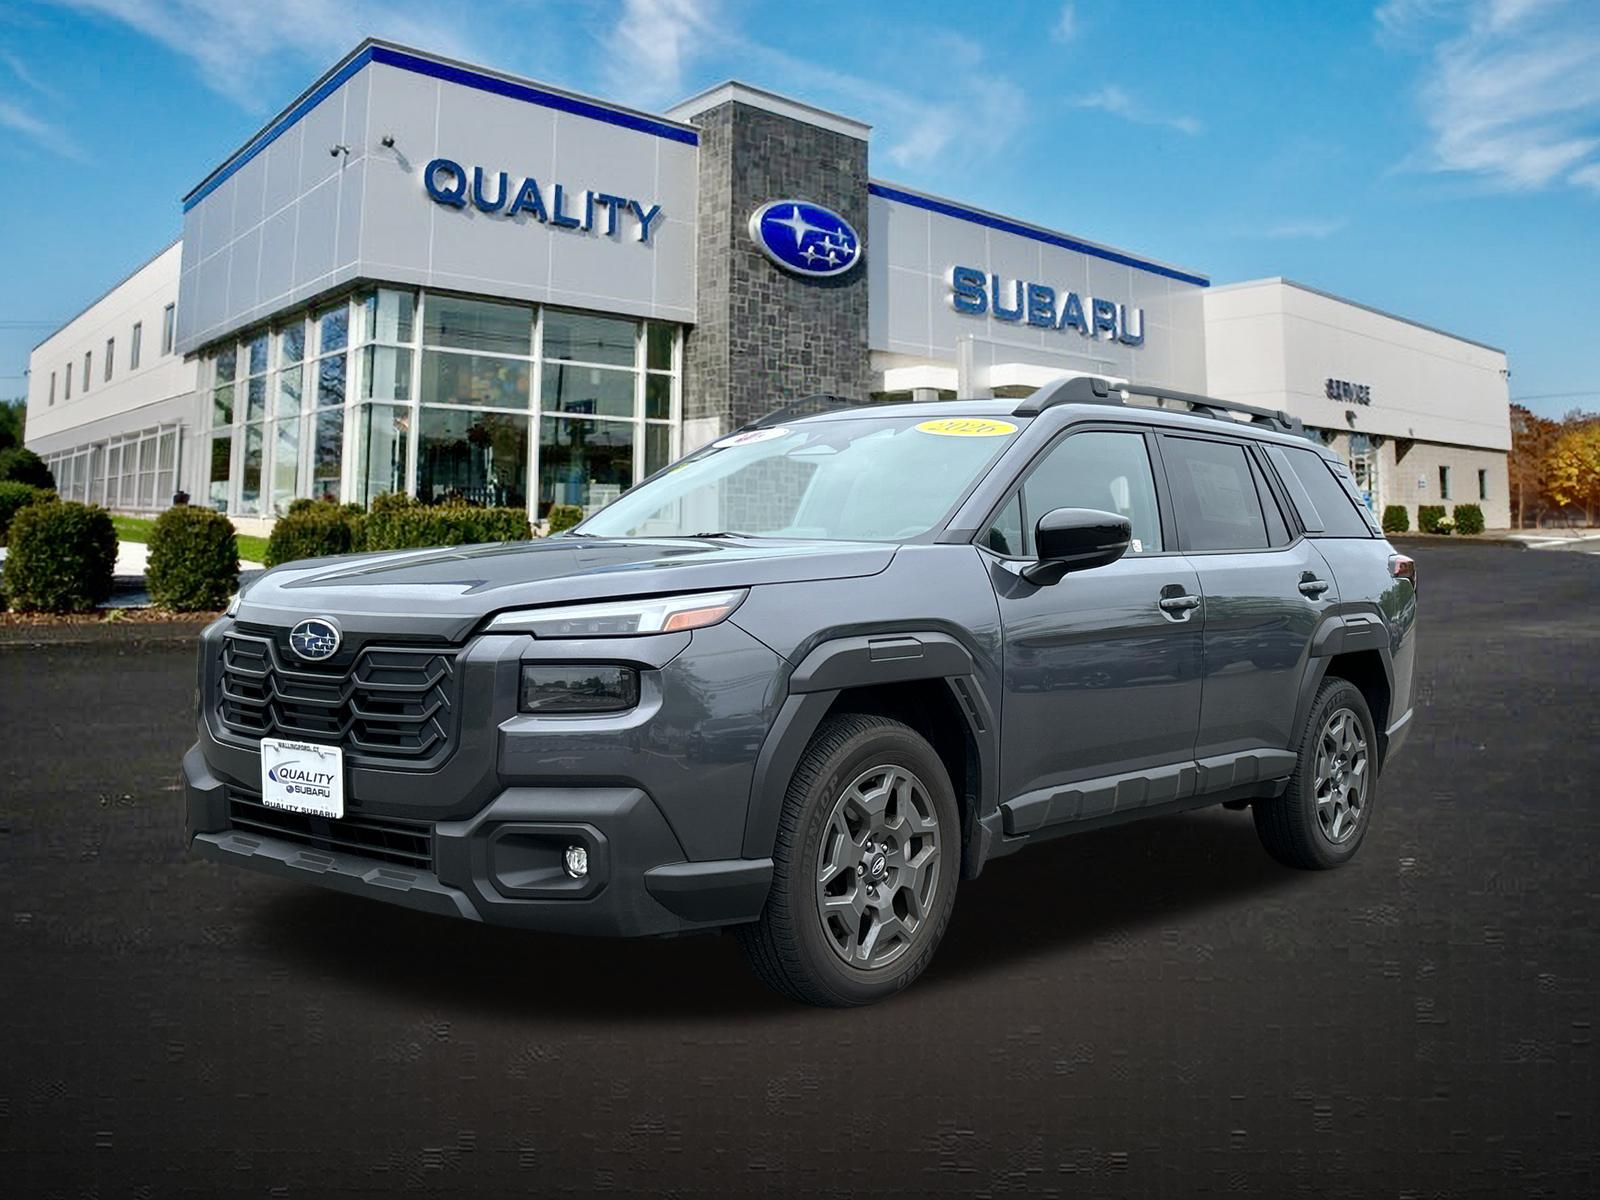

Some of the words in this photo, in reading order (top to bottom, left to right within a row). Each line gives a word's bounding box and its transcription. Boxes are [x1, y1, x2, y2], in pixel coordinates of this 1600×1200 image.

[423, 158, 662, 242] QUALITY
[951, 265, 1145, 347] SUBARU
[1325, 378, 1371, 407] SERVICE
[279, 767, 334, 785] QUALITY
[294, 785, 330, 798] SUBARU
[264, 800, 298, 812] QUALITY
[301, 806, 337, 818] SUBARU
